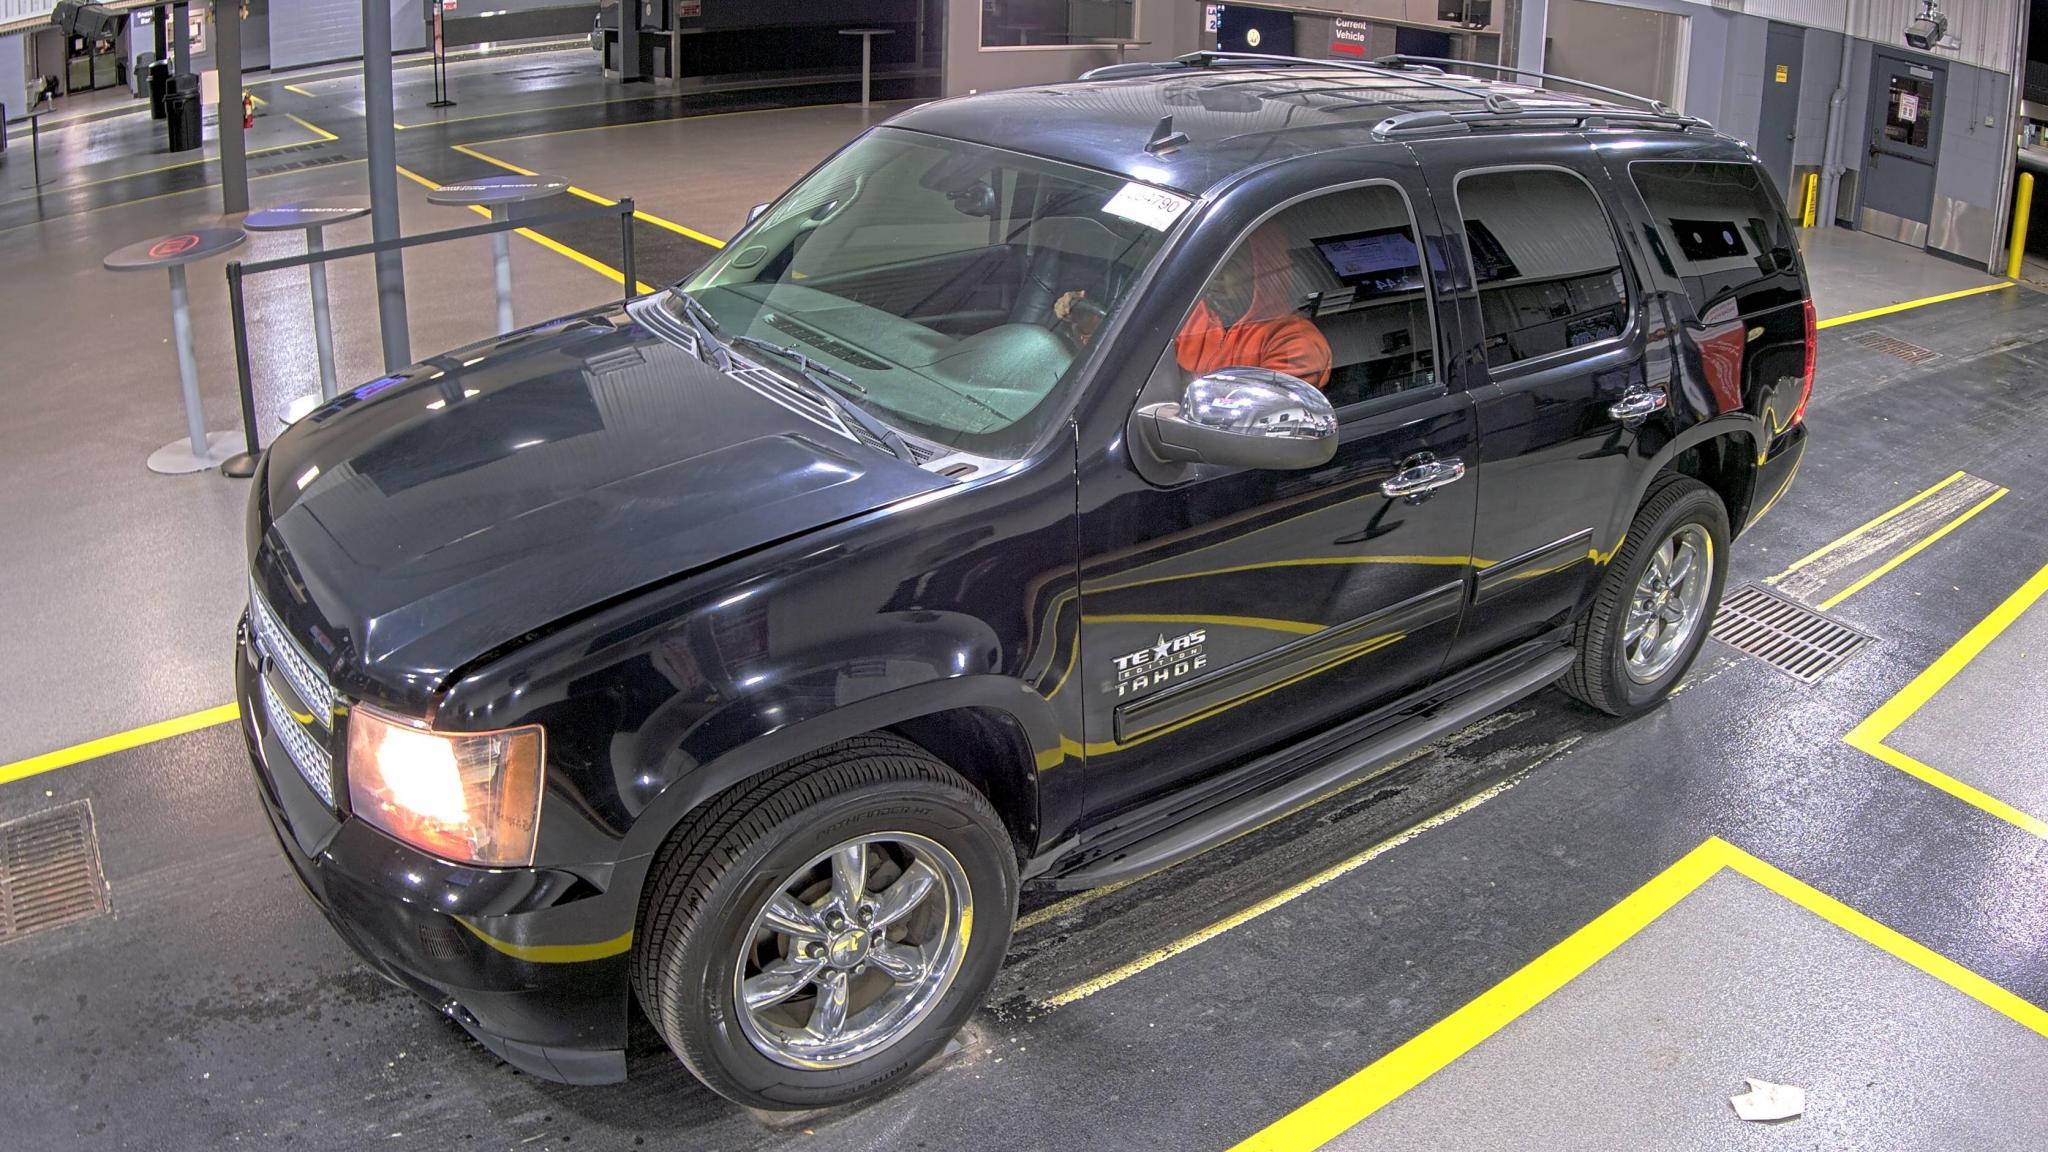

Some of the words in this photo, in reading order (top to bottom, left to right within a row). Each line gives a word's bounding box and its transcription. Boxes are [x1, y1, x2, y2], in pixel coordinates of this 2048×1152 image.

[1209, 20, 1216, 30] 2
[1335, 17, 1367, 30] Current
[1335, 29, 1365, 41] Vehicle
[1112, 628, 1207, 670] TEXAS
[1123, 647, 1199, 679] EDITION
[1114, 653, 1207, 697] TAHOE
